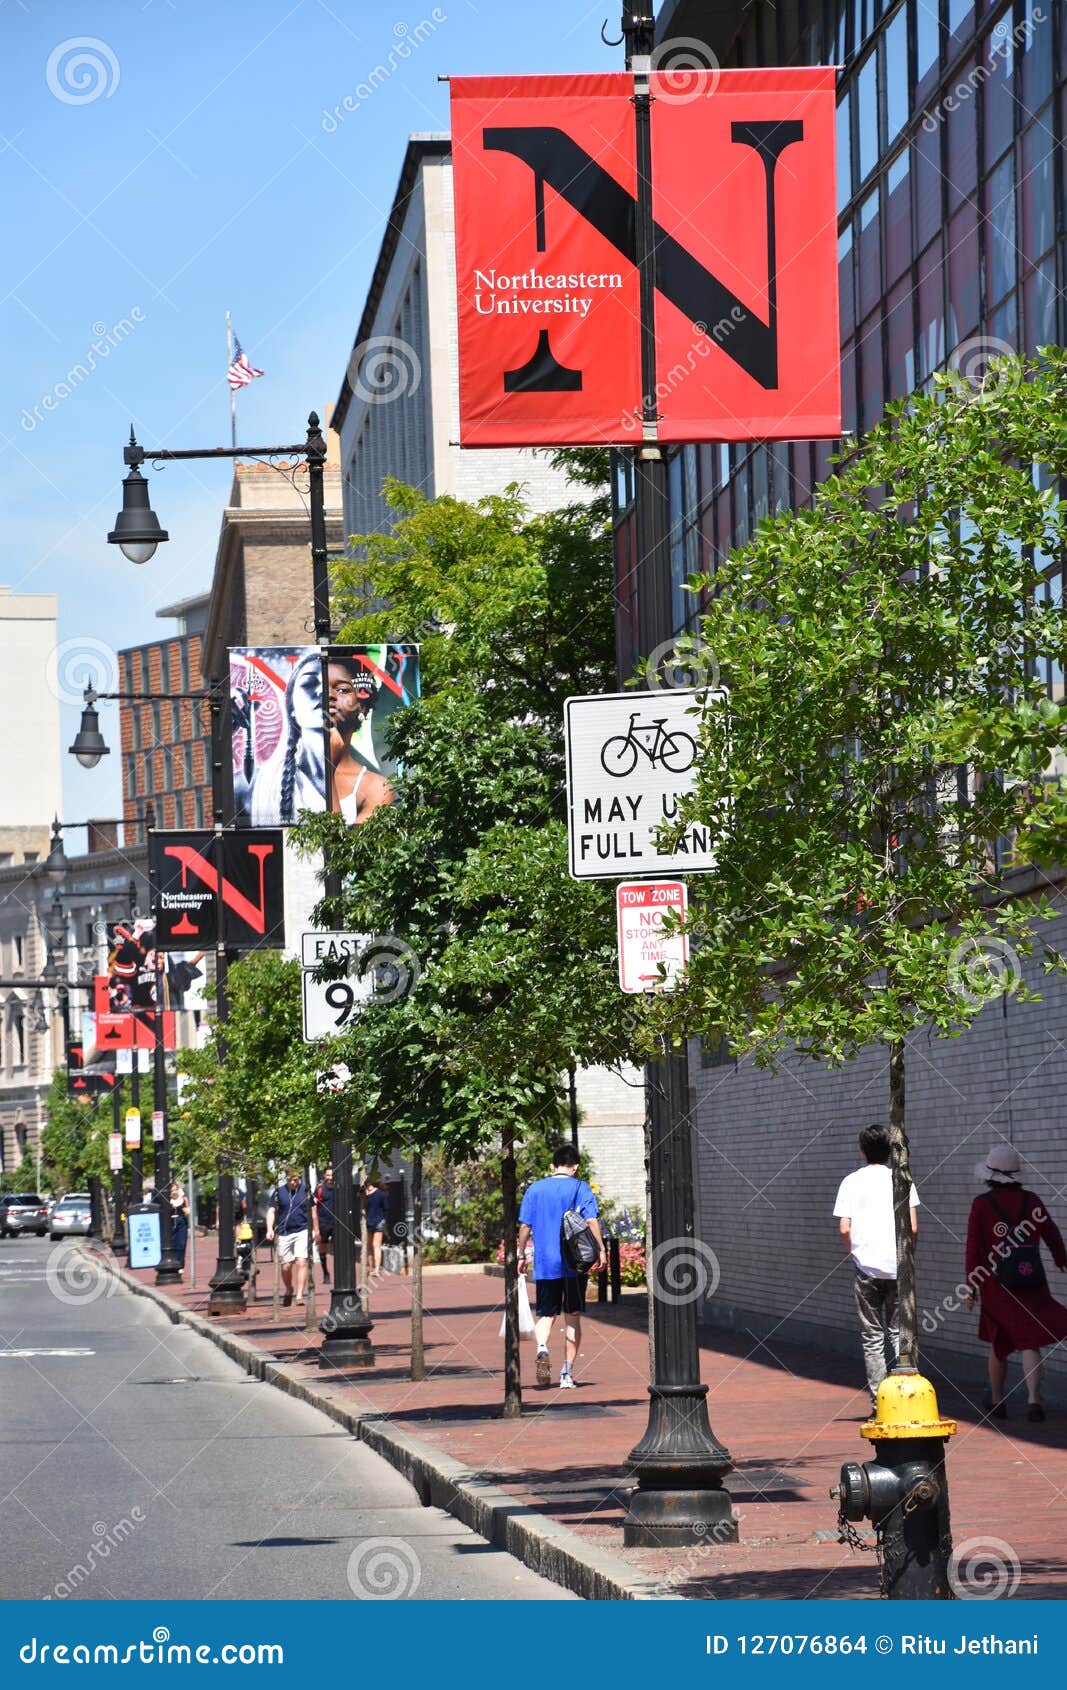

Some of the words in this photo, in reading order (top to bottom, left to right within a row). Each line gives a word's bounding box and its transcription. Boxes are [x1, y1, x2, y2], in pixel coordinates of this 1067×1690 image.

[482, 119, 804, 393] N
[474, 268, 623, 291] Northeastern
[474, 293, 593, 317] University
[584, 794, 643, 824] MAY
[581, 831, 643, 860] FULL
[161, 892, 213, 901] Northeastern
[161, 901, 203, 910] University
[622, 891, 646, 904] TOW
[651, 888, 681, 902] ZONE
[640, 911, 663, 926] NO
[316, 940, 361, 959] EAST
[642, 940, 664, 951] ANY
[641, 951, 666, 961] TIME
[325, 983, 354, 1027] 9
